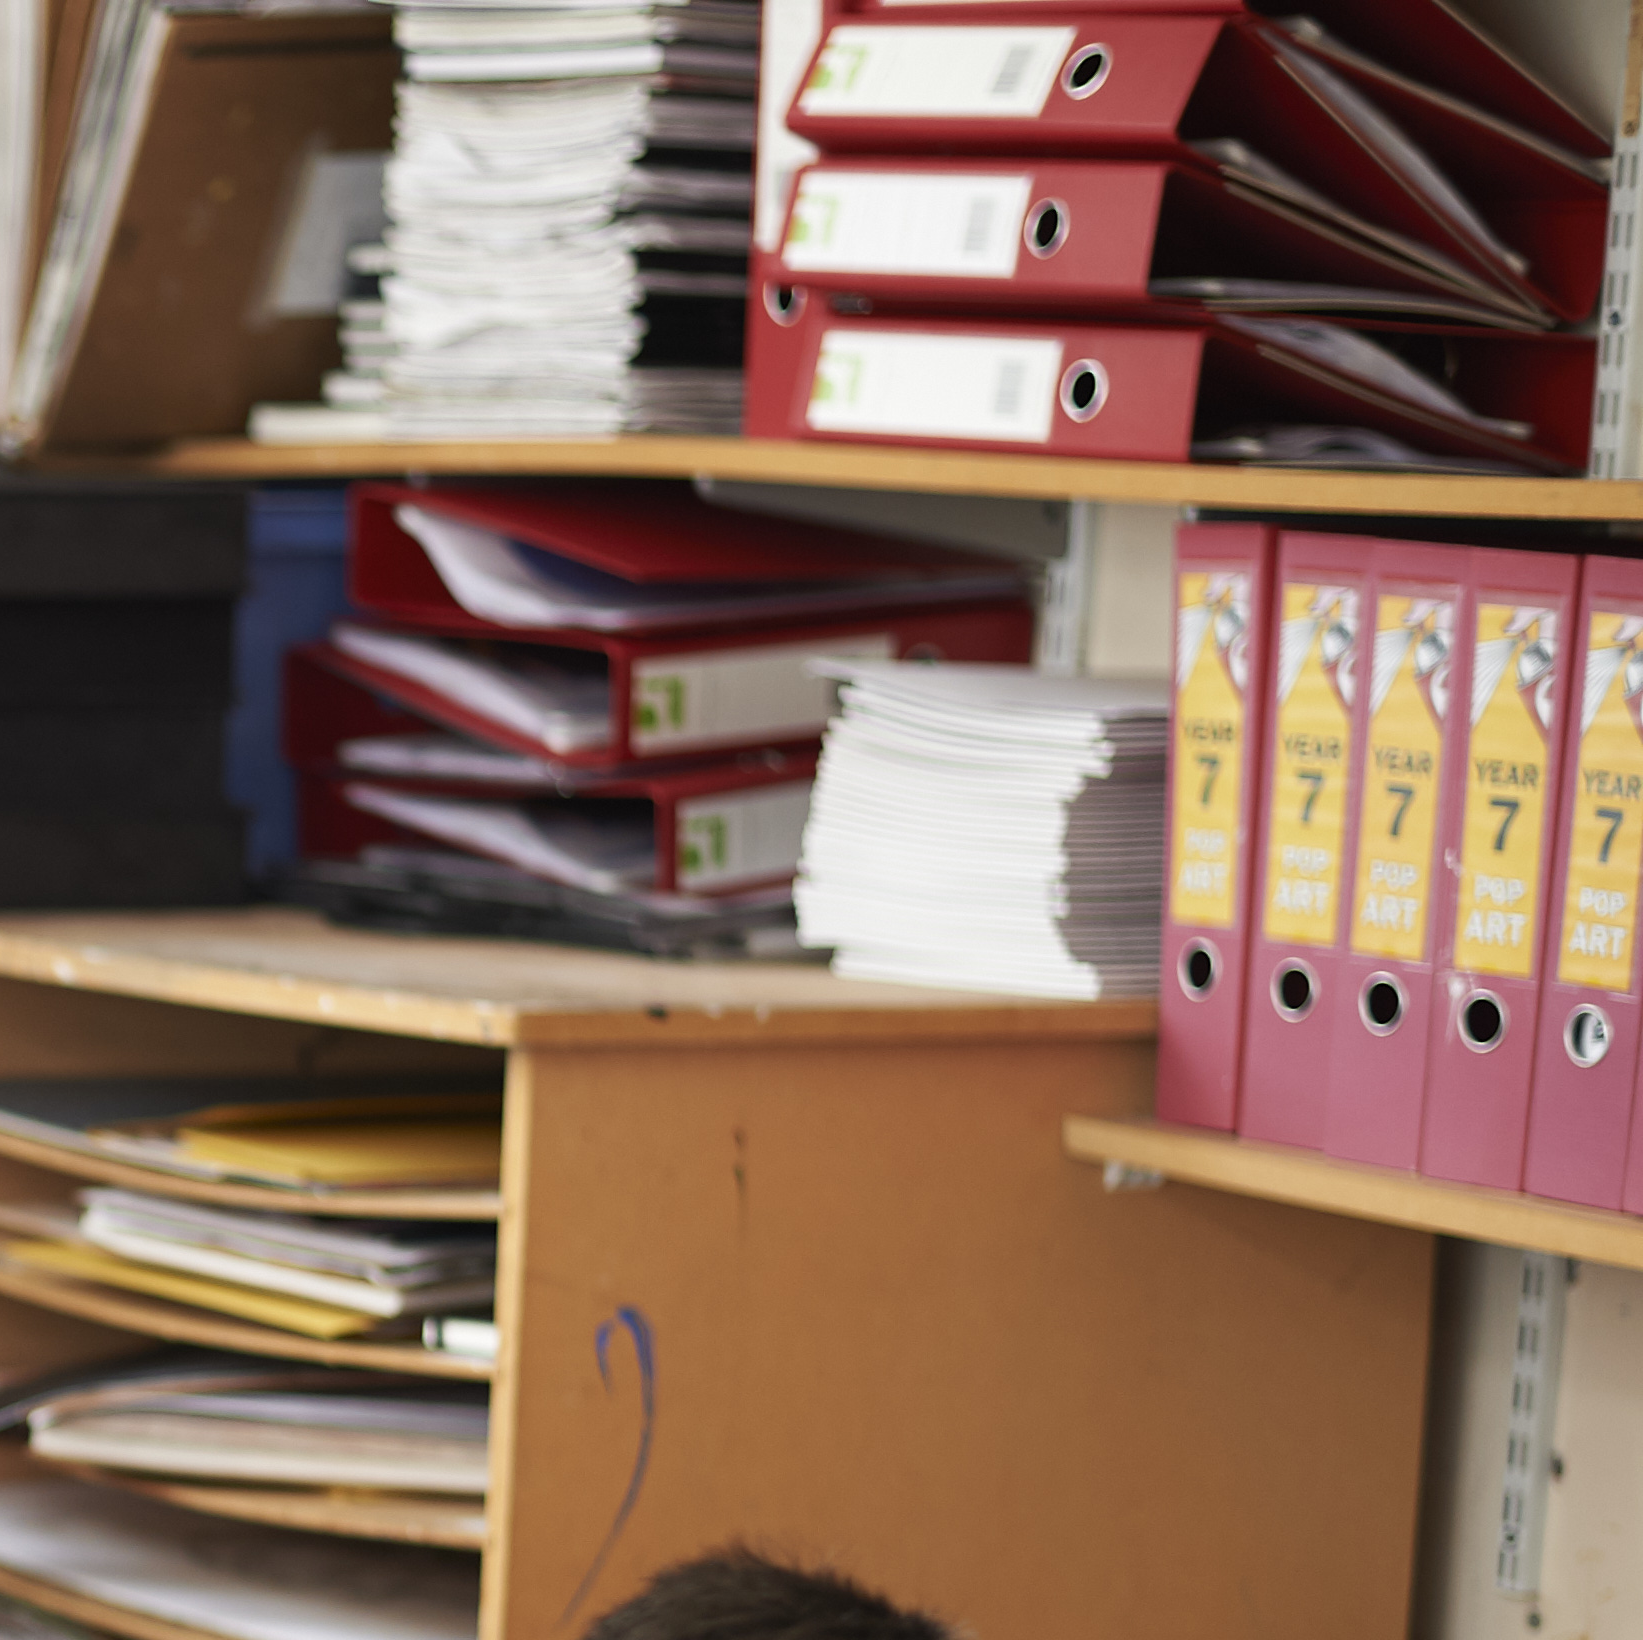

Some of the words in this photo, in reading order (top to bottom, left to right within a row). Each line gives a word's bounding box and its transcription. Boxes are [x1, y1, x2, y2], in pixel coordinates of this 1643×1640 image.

[1282, 733, 1342, 760] YEAR
[1374, 746, 1433, 774] YEAR
[1196, 755, 1221, 806] 7
[1475, 758, 1539, 787] YEAR
[1583, 769, 1642, 800] YEAR
[1297, 771, 1325, 823] 7
[1386, 785, 1416, 838] 7
[1489, 797, 1521, 852] 7
[1595, 807, 1625, 864] 7
[1281, 845, 1330, 875] POP
[1370, 860, 1419, 891] POP
[1179, 861, 1227, 894] ART
[1473, 874, 1526, 906] POP
[1273, 879, 1330, 915] ART
[1360, 895, 1419, 932] ART
[1579, 886, 1627, 917] POP
[1464, 910, 1527, 946] ART
[1569, 922, 1627, 961] ART
